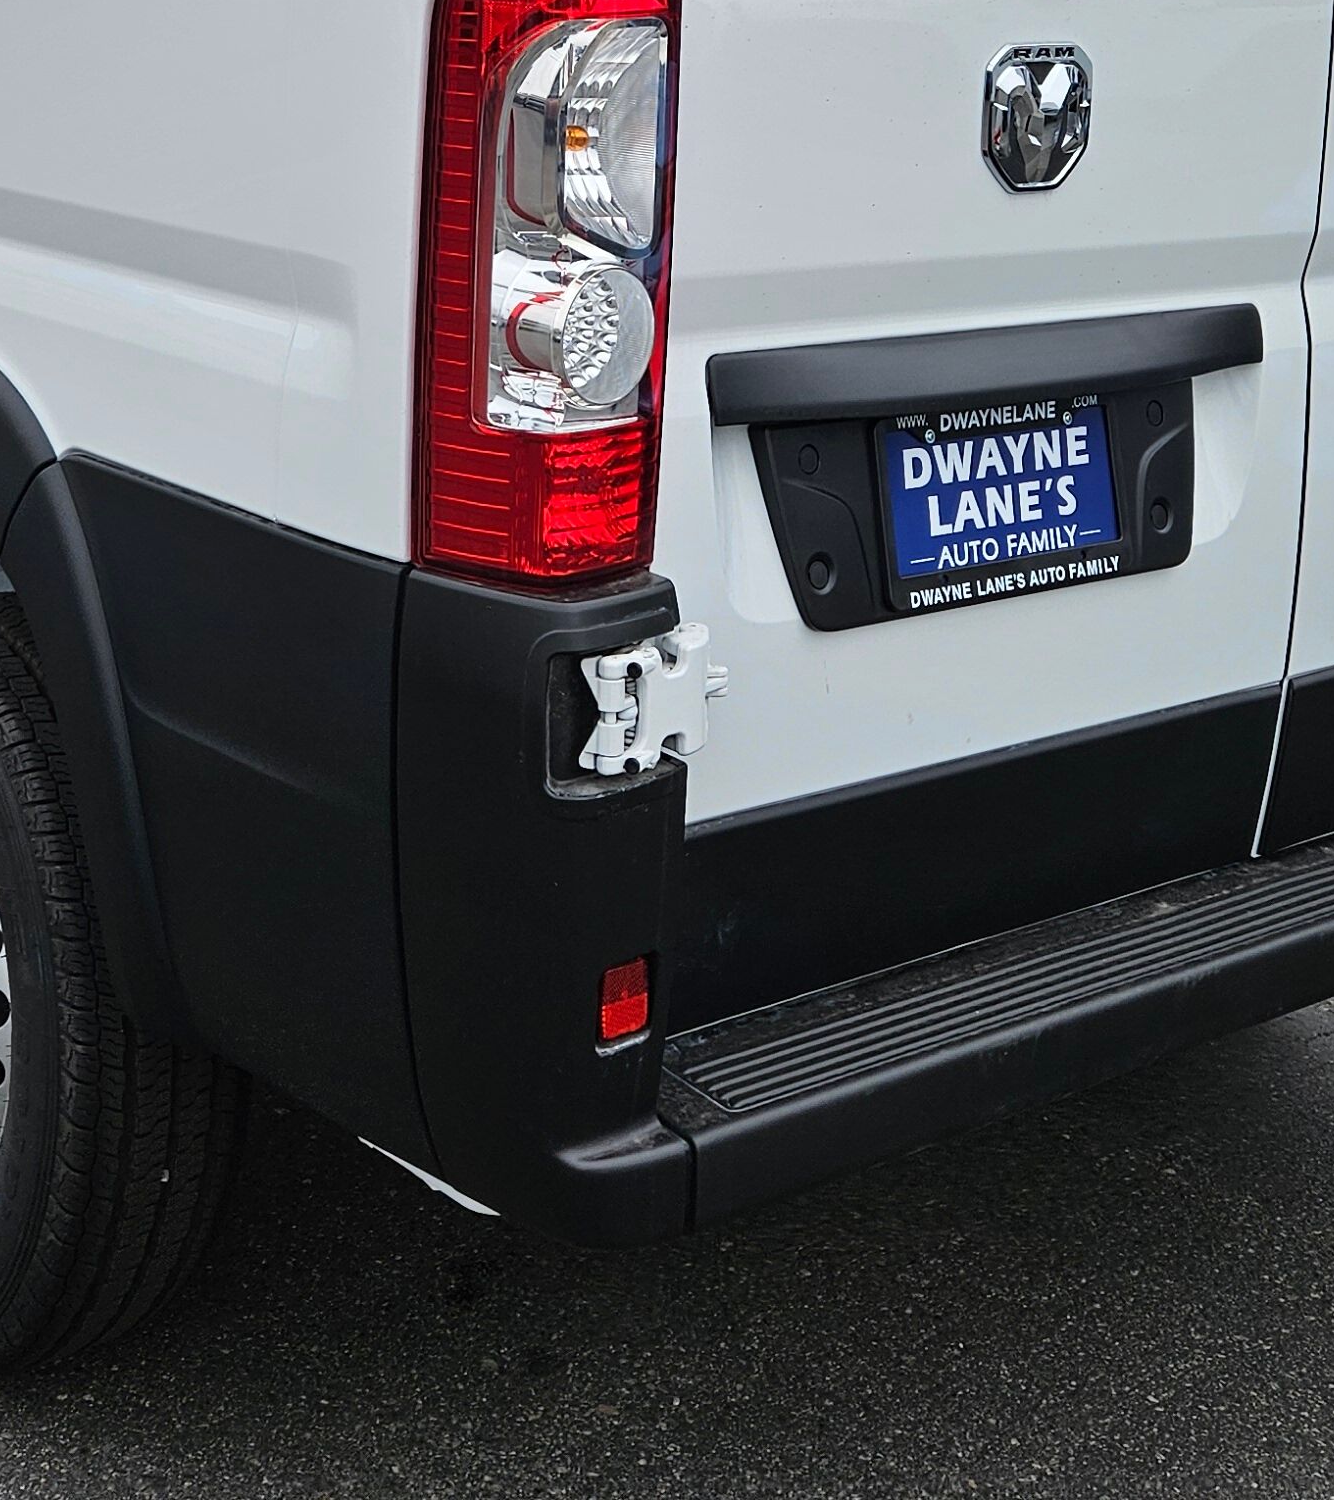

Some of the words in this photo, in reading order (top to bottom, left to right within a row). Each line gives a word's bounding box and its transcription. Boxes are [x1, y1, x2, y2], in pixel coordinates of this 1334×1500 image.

[1013, 47, 1075, 59] RAM
[940, 401, 1056, 432] DWAYNELANE
[903, 426, 1089, 490] DWAYNE
[928, 475, 1077, 537] LANE'S
[937, 538, 999, 569] AUTO
[1007, 524, 1077, 556] FAMILY
[910, 583, 973, 609] DWAYNE
[976, 574, 1026, 597] LANE'S
[1029, 565, 1066, 588] AUTO
[1068, 555, 1121, 580] FAMILY
